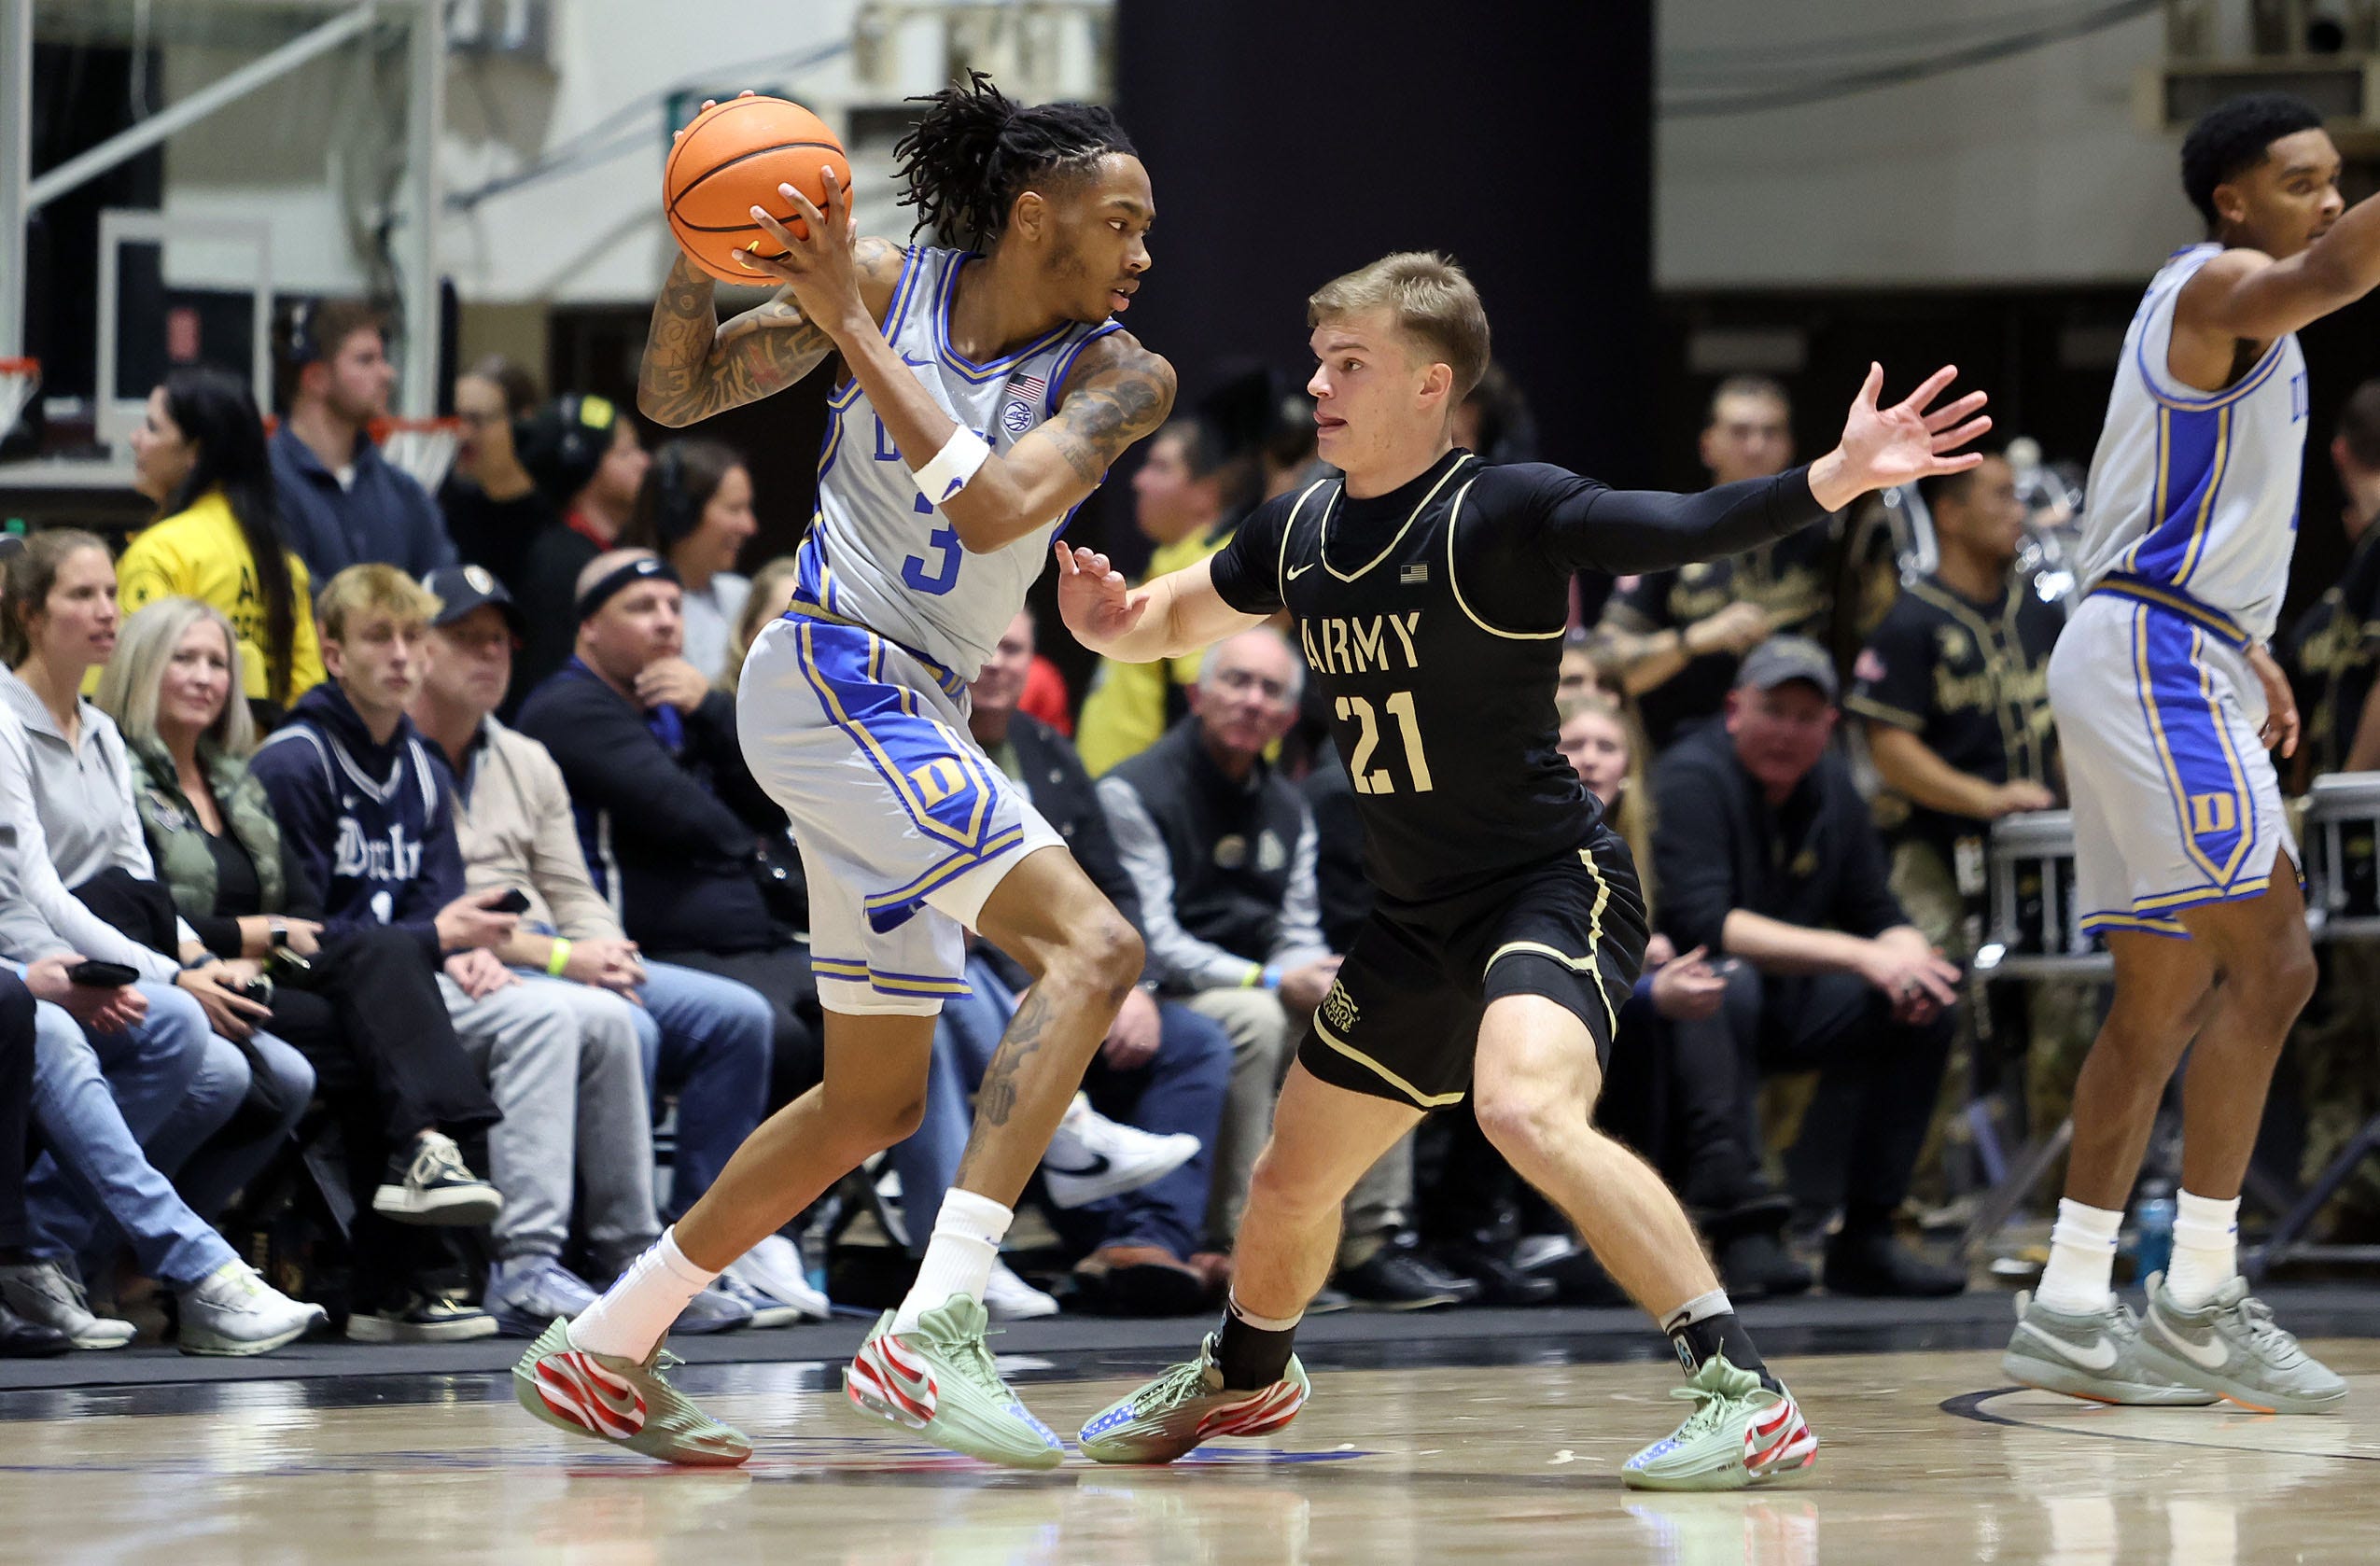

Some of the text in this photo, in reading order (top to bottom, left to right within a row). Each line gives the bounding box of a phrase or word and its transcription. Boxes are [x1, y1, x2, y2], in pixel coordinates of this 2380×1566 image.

[902, 492, 963, 596] 3
[1301, 611, 1421, 675] ARMY
[1335, 691, 1434, 795] 21
[907, 757, 967, 810] D
[2189, 791, 2236, 834] D
